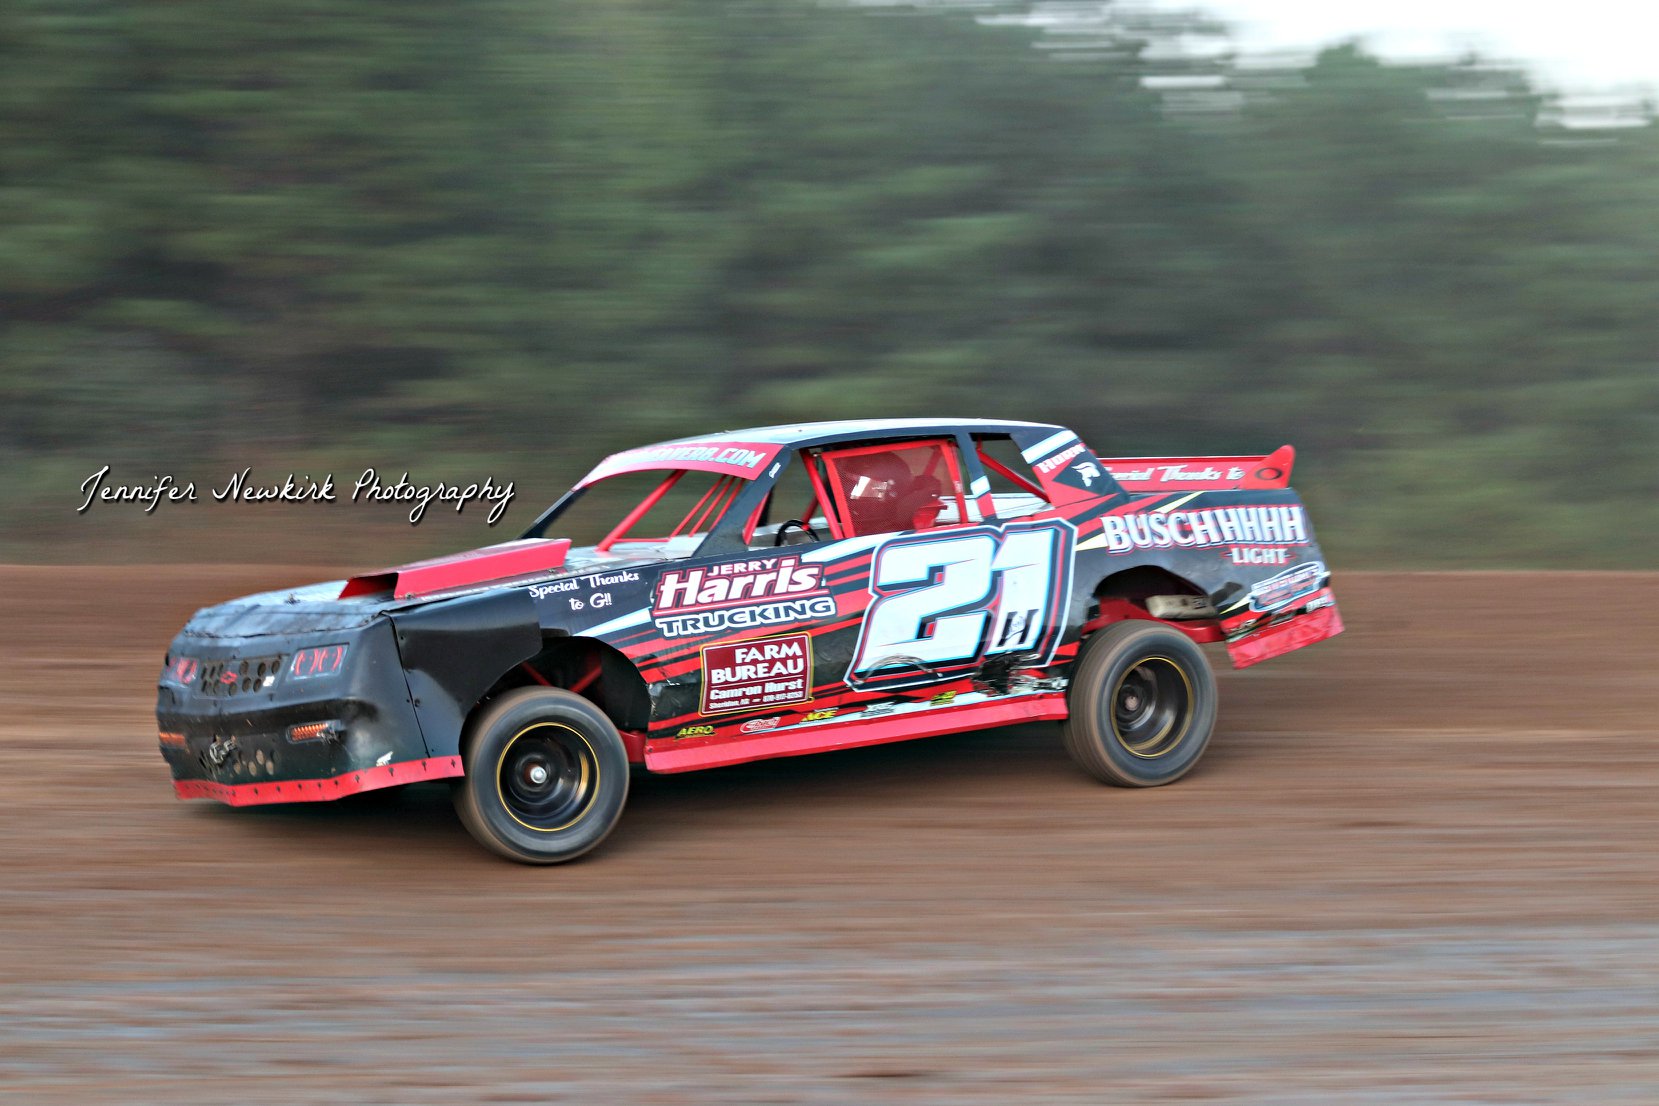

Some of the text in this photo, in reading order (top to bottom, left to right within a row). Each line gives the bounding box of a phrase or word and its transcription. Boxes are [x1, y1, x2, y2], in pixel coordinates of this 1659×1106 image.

[707, 558, 778, 577] JERRY
[1230, 547, 1288, 565] LIGHT
[528, 570, 640, 599] Special Thanks
[656, 557, 821, 610] Harris
[569, 592, 612, 611] to G!!
[848, 522, 1073, 689] 21
[655, 597, 836, 637] TRUCKING
[735, 641, 803, 664] FARM
[711, 658, 804, 684] BUREAU
[677, 725, 714, 736] AERO
